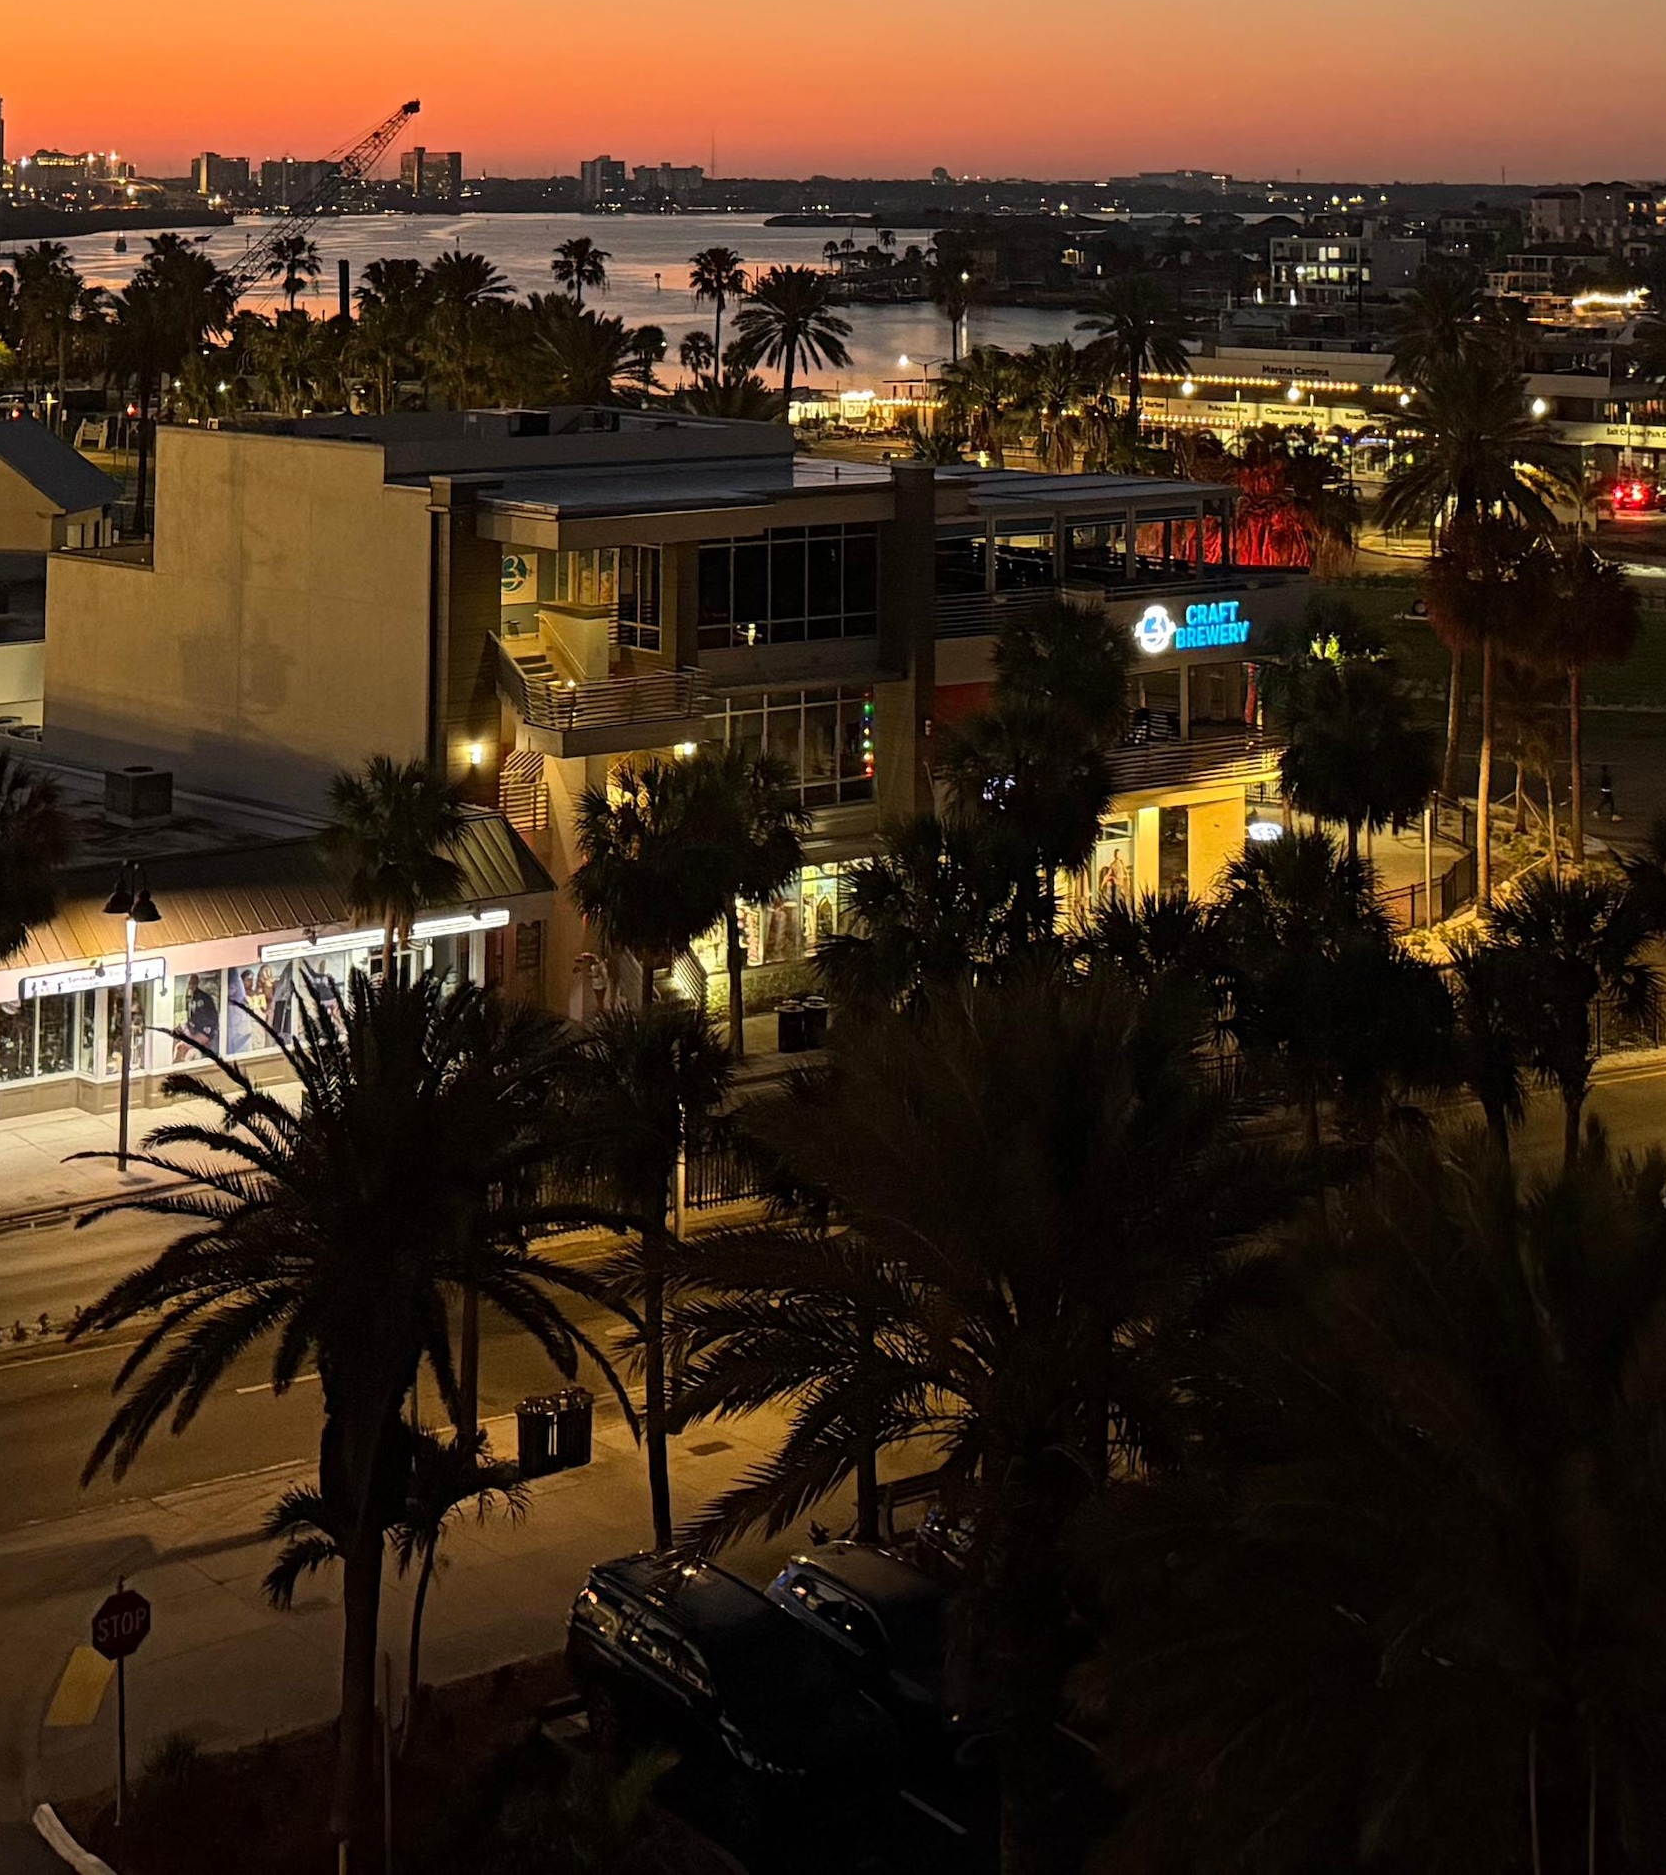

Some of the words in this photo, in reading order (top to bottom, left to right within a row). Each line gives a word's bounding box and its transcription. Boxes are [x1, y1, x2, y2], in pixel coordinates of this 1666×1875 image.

[1262, 365, 1293, 375] Marina
[1294, 367, 1330, 377] Cantina
[1265, 408, 1300, 417] Clearwater
[1301, 410, 1325, 418] Marina
[1185, 601, 1239, 625] CRAFT
[1175, 620, 1250, 649] BREWERY
[96, 1607, 148, 1643] STOP
